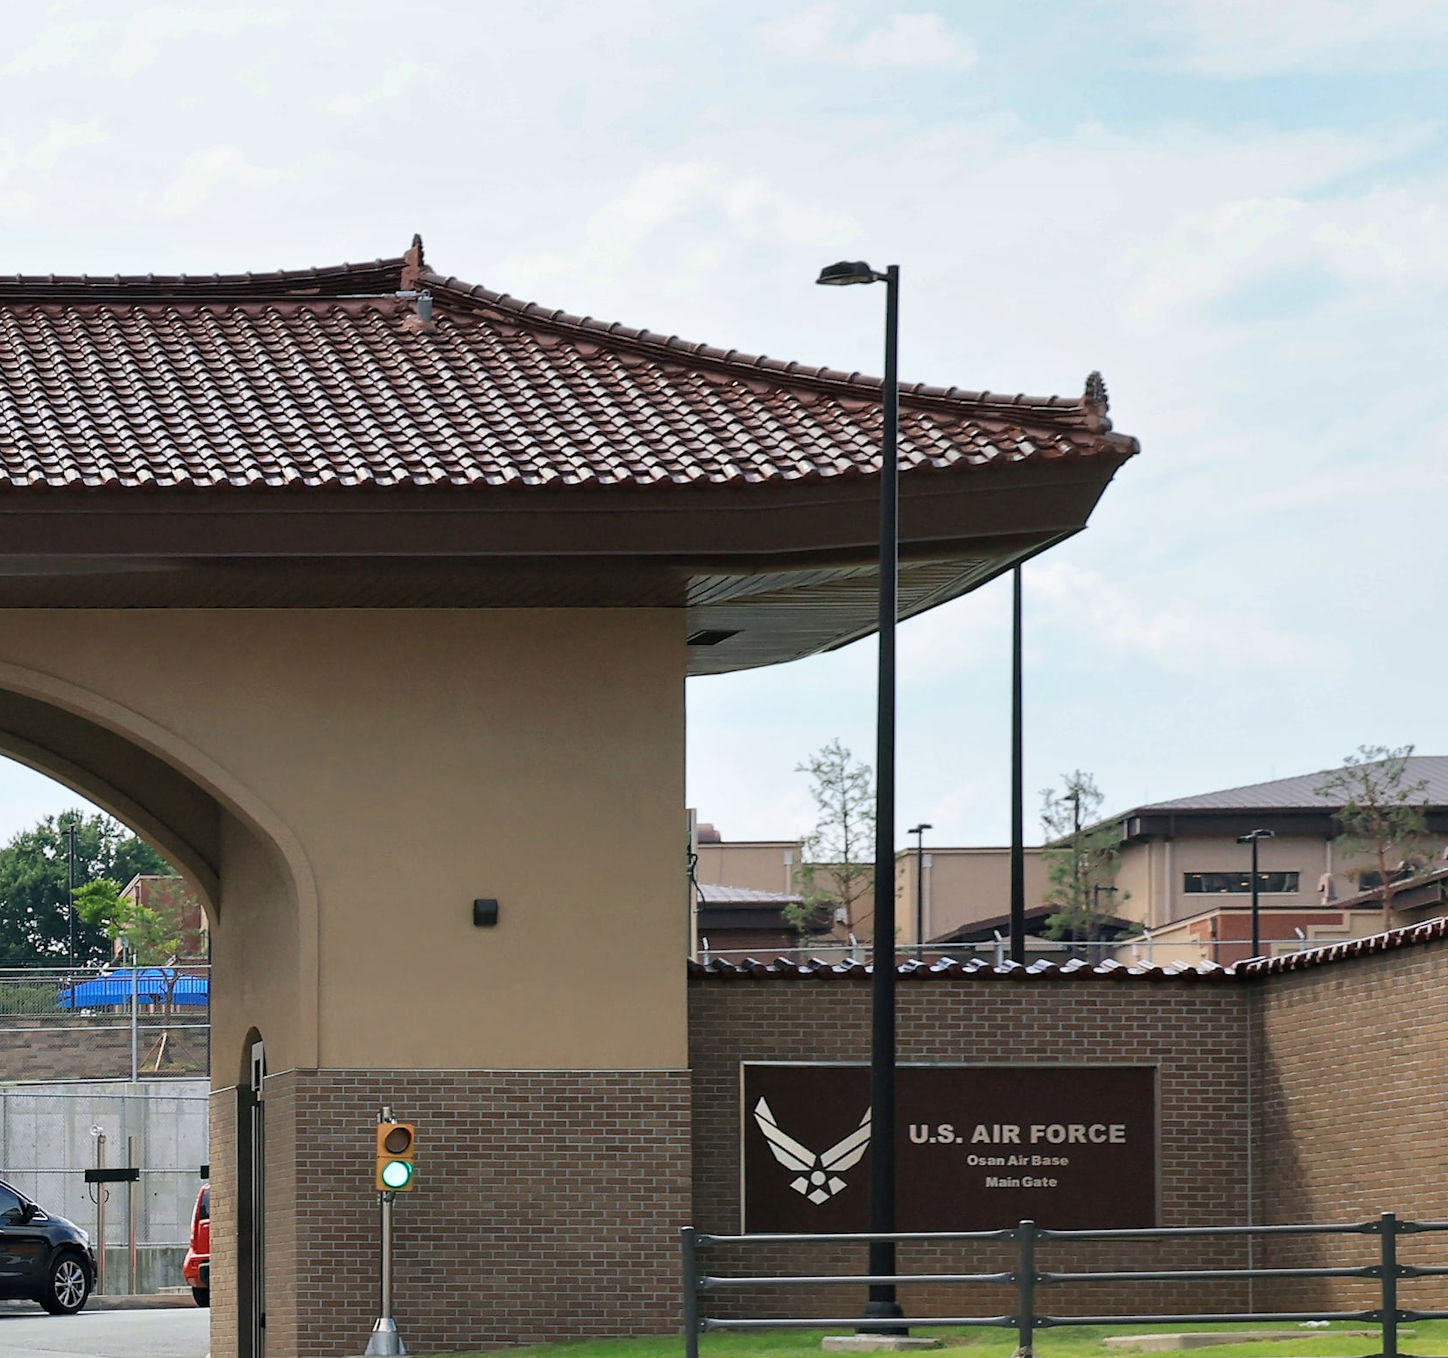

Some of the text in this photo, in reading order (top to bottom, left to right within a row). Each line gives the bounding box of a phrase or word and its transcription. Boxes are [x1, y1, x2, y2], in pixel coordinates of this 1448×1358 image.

[908, 1123, 1127, 1145] U.S. AIR FORCE
[967, 1154, 1069, 1167] Osan Air Base
[985, 1176, 1058, 1188] Main Gate
